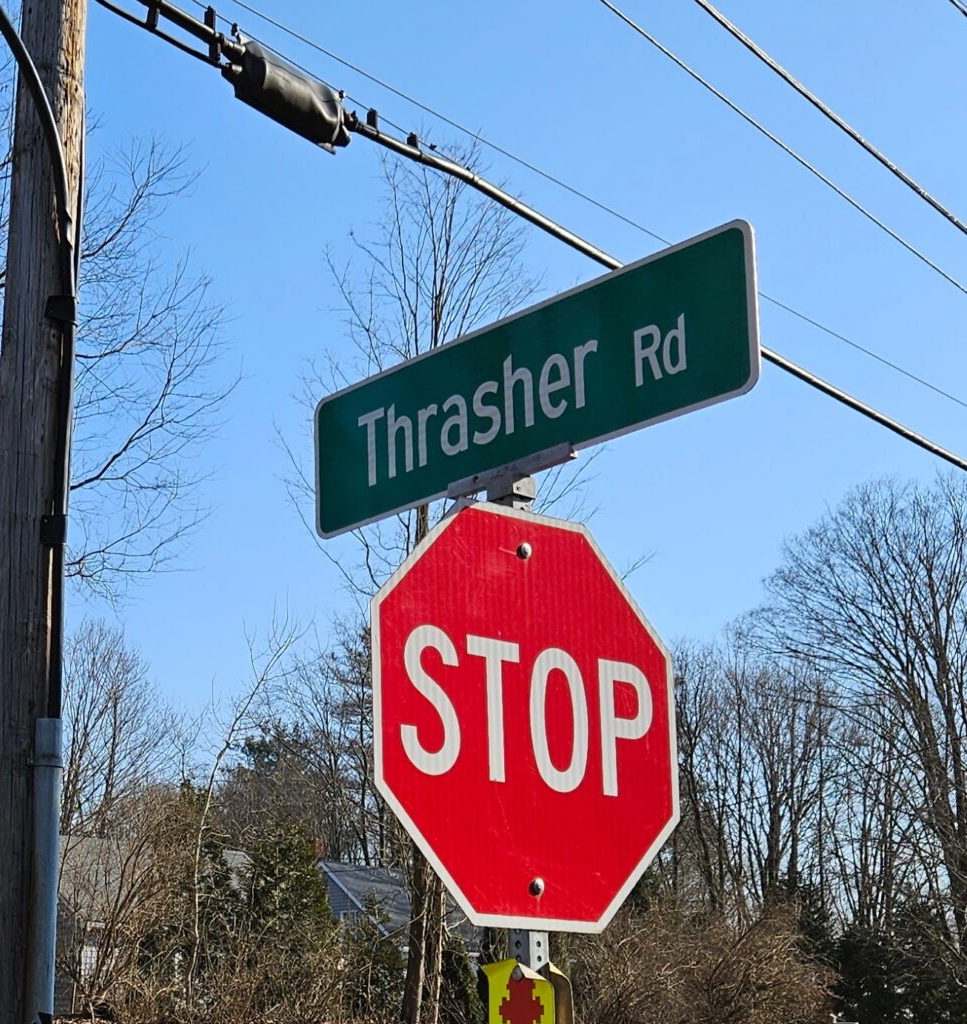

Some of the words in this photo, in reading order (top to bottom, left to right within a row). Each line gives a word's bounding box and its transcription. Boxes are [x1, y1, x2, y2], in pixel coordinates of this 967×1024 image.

[357, 340, 599, 487] Thrasher
[633, 313, 688, 387] Rd
[400, 624, 654, 798] STOP
